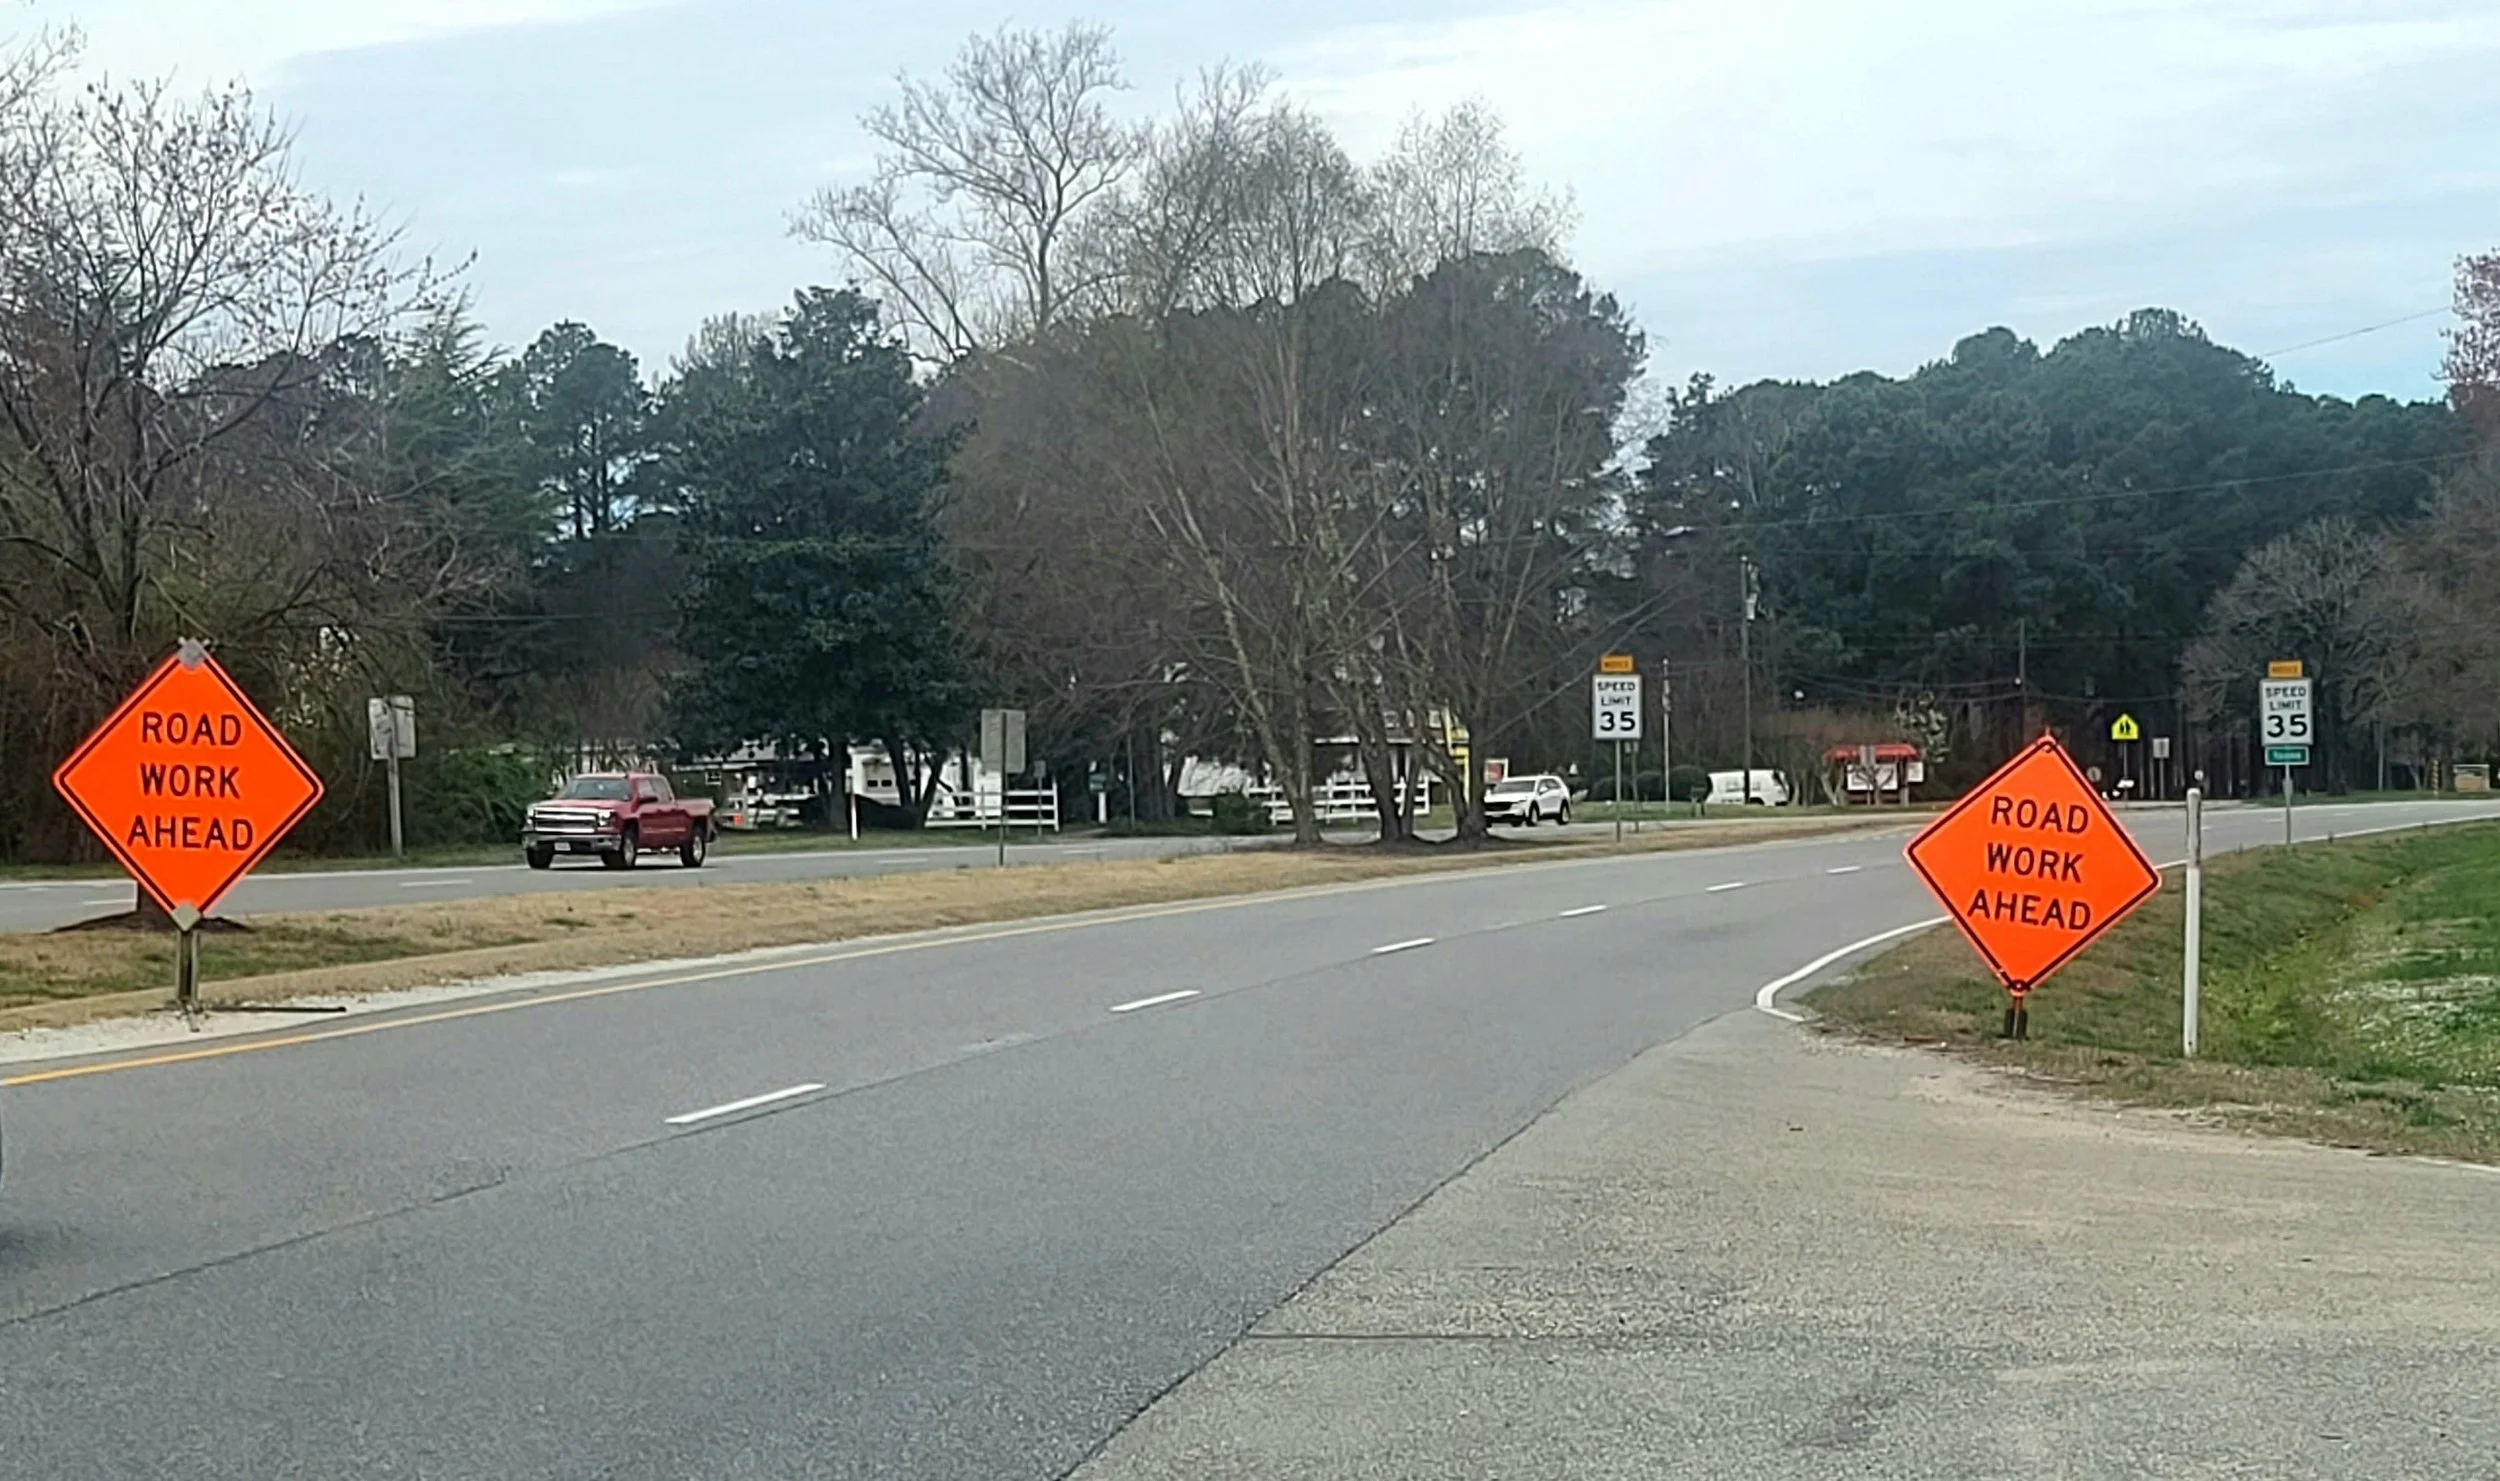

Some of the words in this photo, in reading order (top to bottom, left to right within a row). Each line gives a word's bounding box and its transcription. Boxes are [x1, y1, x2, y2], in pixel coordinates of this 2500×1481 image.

[1598, 682, 1635, 691] SPEED
[1601, 696, 1630, 706] LIMIT
[2265, 686, 2306, 698] SPEED
[2269, 700, 2302, 711] LIMIT
[142, 711, 241, 746] ROAD
[1600, 711, 1635, 731] 35
[2267, 714, 2308, 737] 35
[140, 763, 240, 799] WORK
[1991, 795, 2089, 834] ROAD
[127, 814, 253, 851] AHEAD
[1987, 842, 2084, 884] WORK
[1967, 888, 2091, 931] AHEAD
